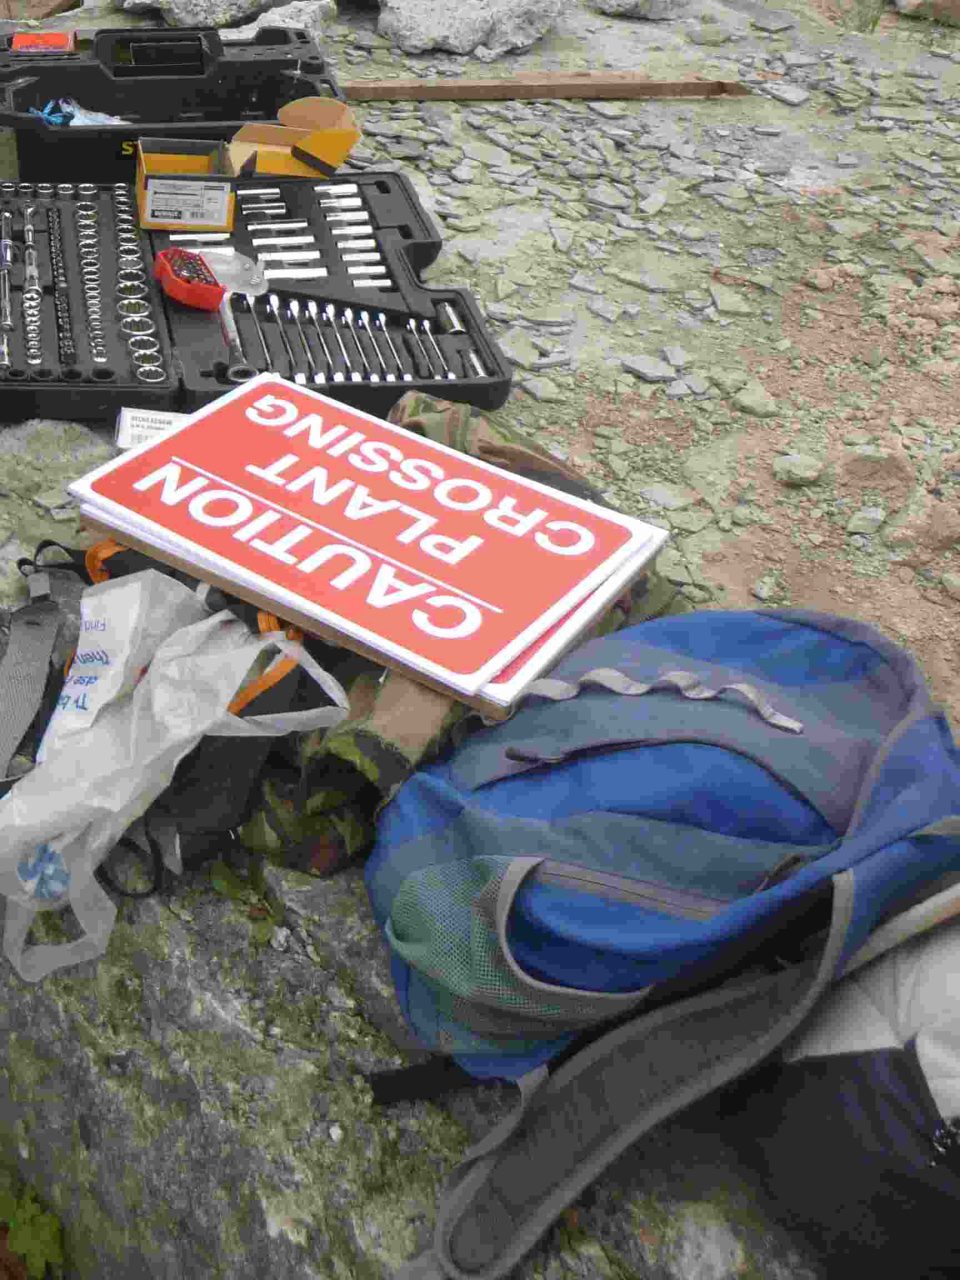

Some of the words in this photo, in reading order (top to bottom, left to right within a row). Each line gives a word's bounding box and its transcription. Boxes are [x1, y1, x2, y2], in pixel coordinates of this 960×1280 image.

[133, 468, 483, 641] CAUTION
[244, 392, 597, 557] CROSSING
[246, 453, 484, 566] PLANT
